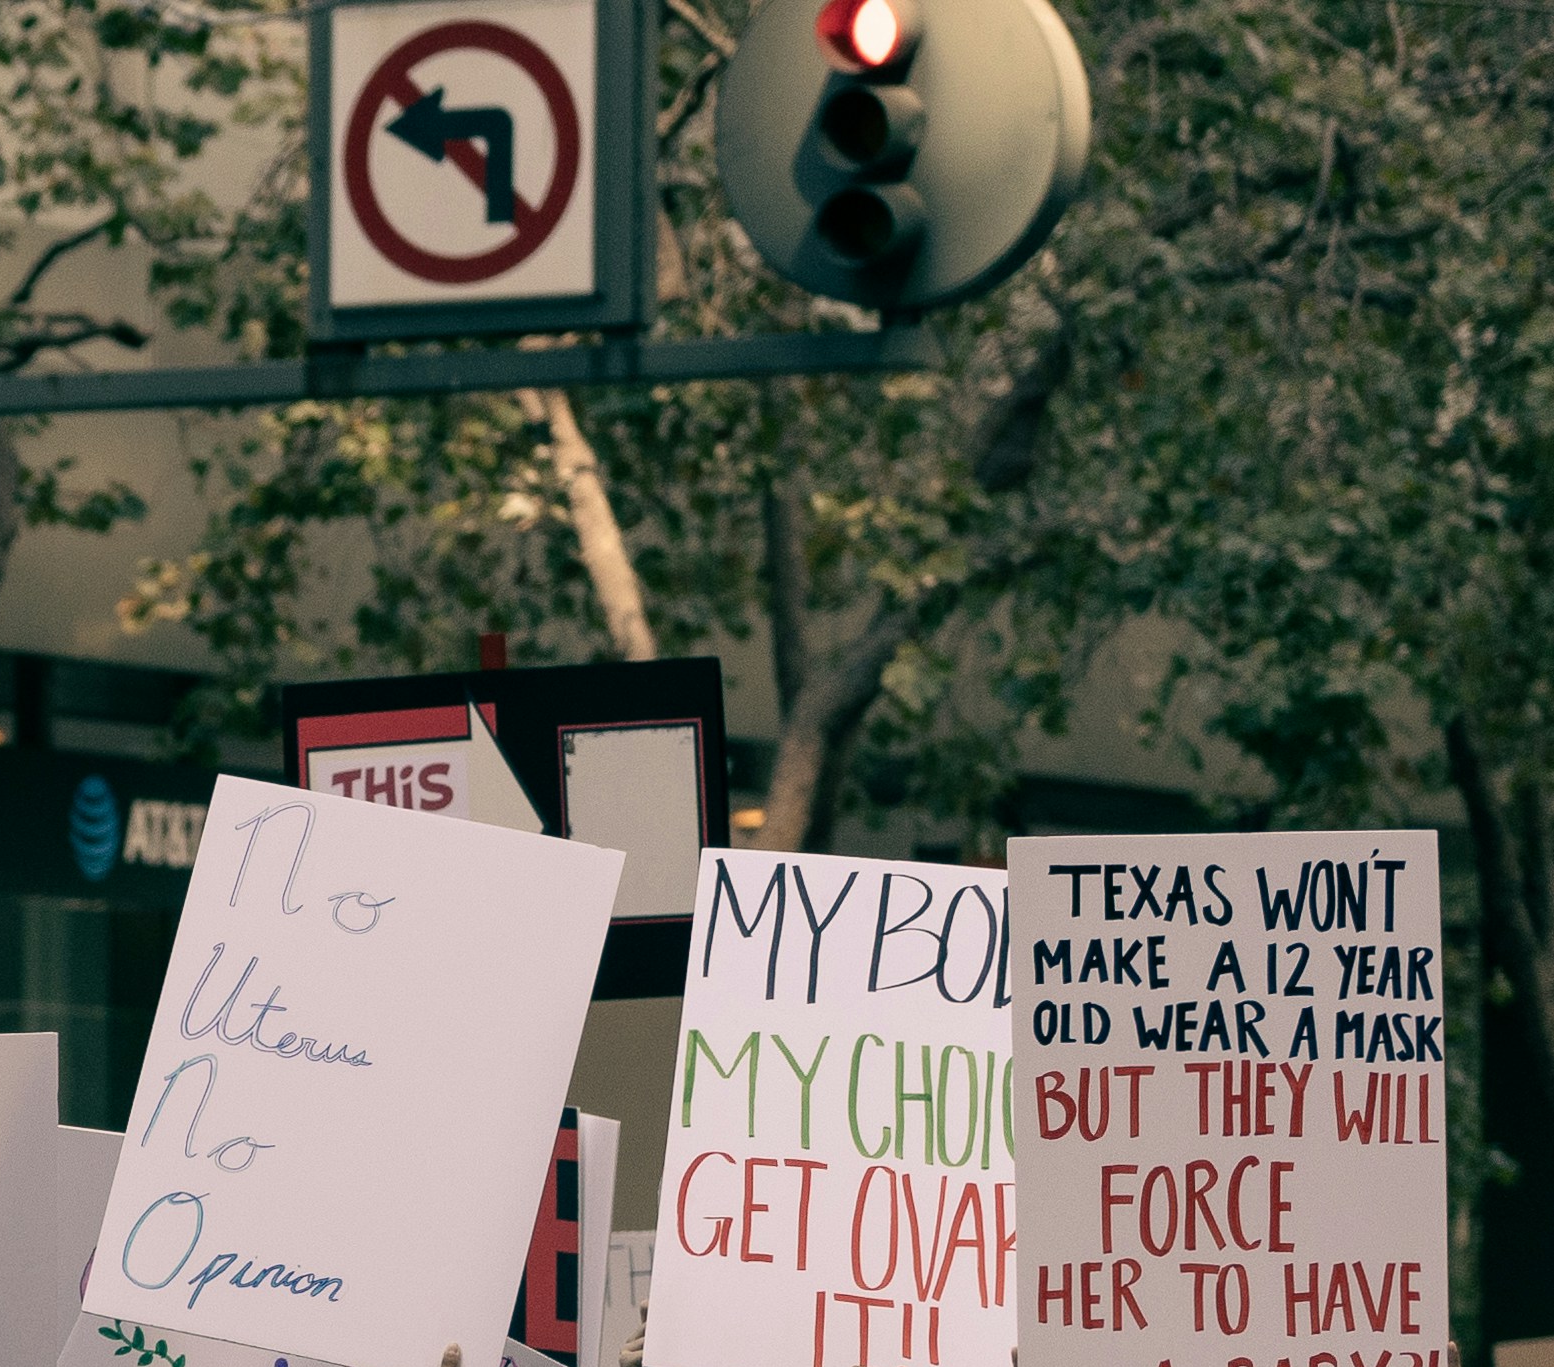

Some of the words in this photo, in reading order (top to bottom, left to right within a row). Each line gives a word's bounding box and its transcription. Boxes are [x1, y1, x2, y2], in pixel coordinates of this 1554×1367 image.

[703, 858, 859, 1004] MY
[1048, 864, 1233, 926] TEXAS
[1256, 848, 1406, 932] WON'T
[180, 942, 373, 1068] Uterus
[1033, 935, 1169, 989] MAKE
[1206, 940, 1246, 993] A
[1267, 942, 1314, 996] 12
[1333, 944, 1435, 1001] YEAR
[1033, 1000, 1111, 1046] OLD
[1133, 1000, 1271, 1058] WEAR
[1289, 1005, 1319, 1061] A
[1334, 1010, 1443, 1063] MASK
[682, 1028, 829, 1149] MY
[1036, 1065, 1155, 1141] BUT
[1184, 1059, 1313, 1138] THEY
[1333, 1070, 1440, 1144] WILL
[122, 1190, 344, 1310] Opinion
[677, 1152, 828, 1271] GET
[1101, 1155, 1295, 1257] FORCE
[1037, 1258, 1148, 1332] HER
[1180, 1263, 1250, 1335] TO
[1284, 1259, 1422, 1337] HAVE
